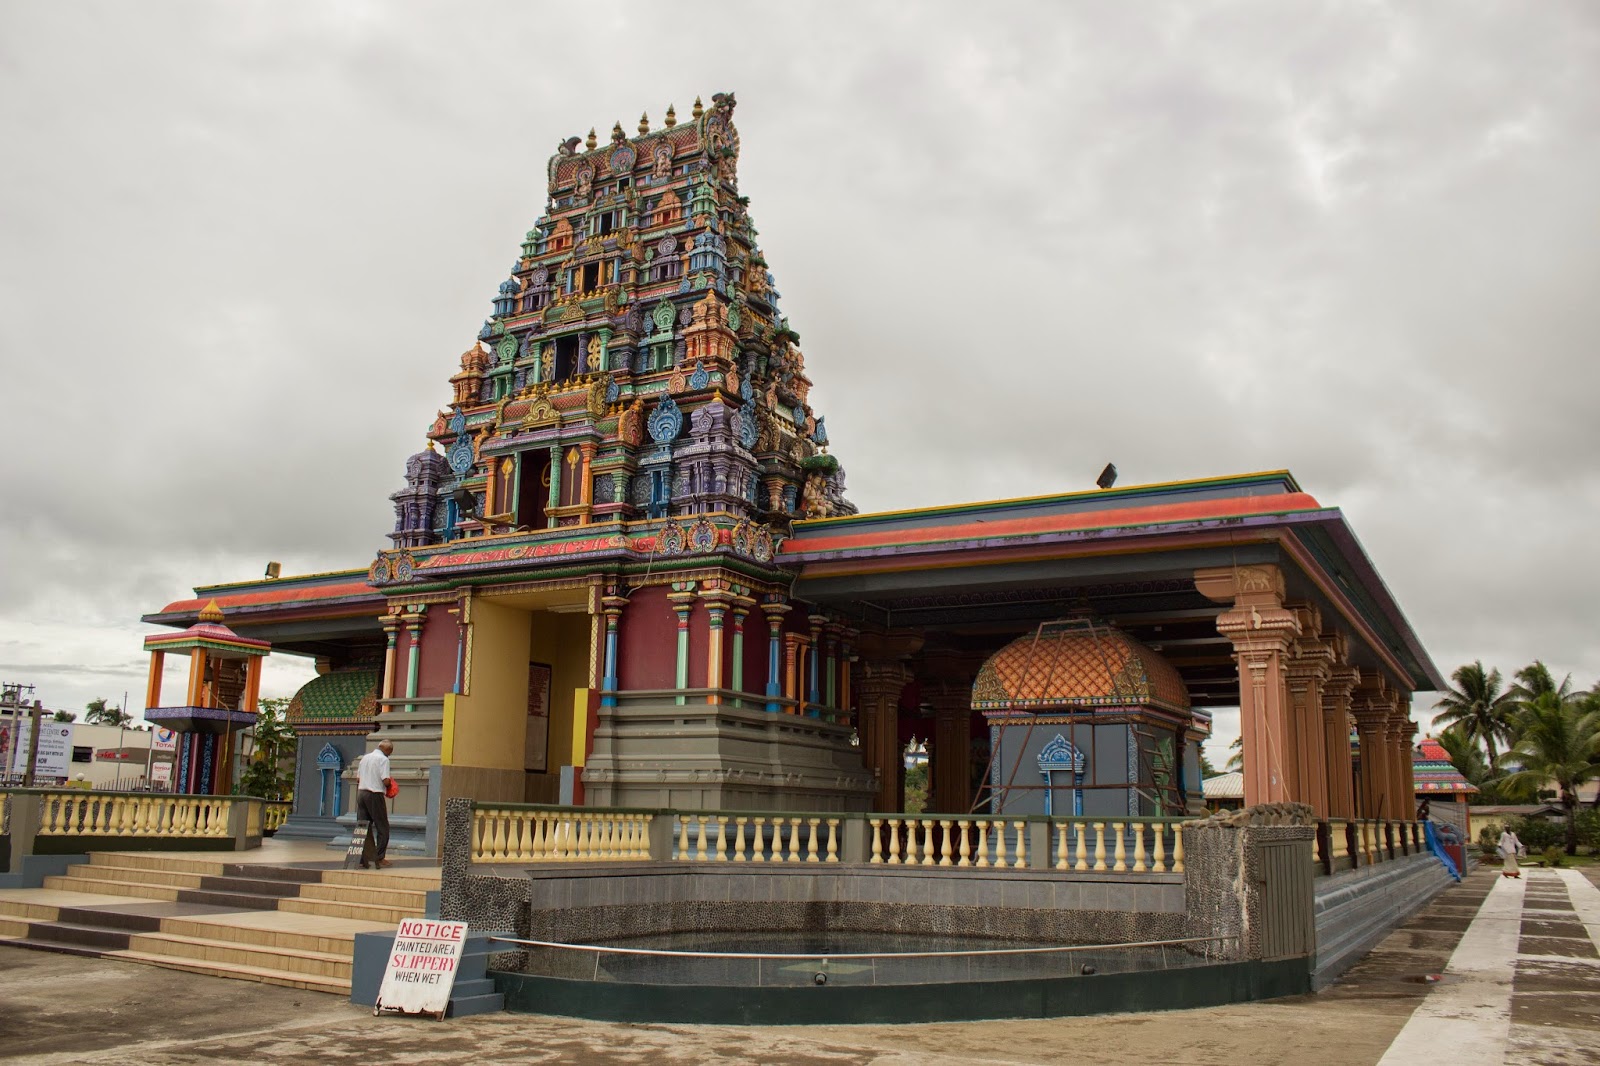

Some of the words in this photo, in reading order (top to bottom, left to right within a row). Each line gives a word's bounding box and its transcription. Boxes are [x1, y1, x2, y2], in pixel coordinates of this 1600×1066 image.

[155, 741, 175, 749] TOTAL
[347, 846, 364, 855] FLOOR
[400, 922, 464, 939] NOTICE
[395, 940, 432, 954] PAINTED
[433, 943, 456, 955] AREA
[391, 954, 458, 972] SLIPPERY
[394, 971, 422, 983] WHEN
[422, 973, 443, 985] WET
